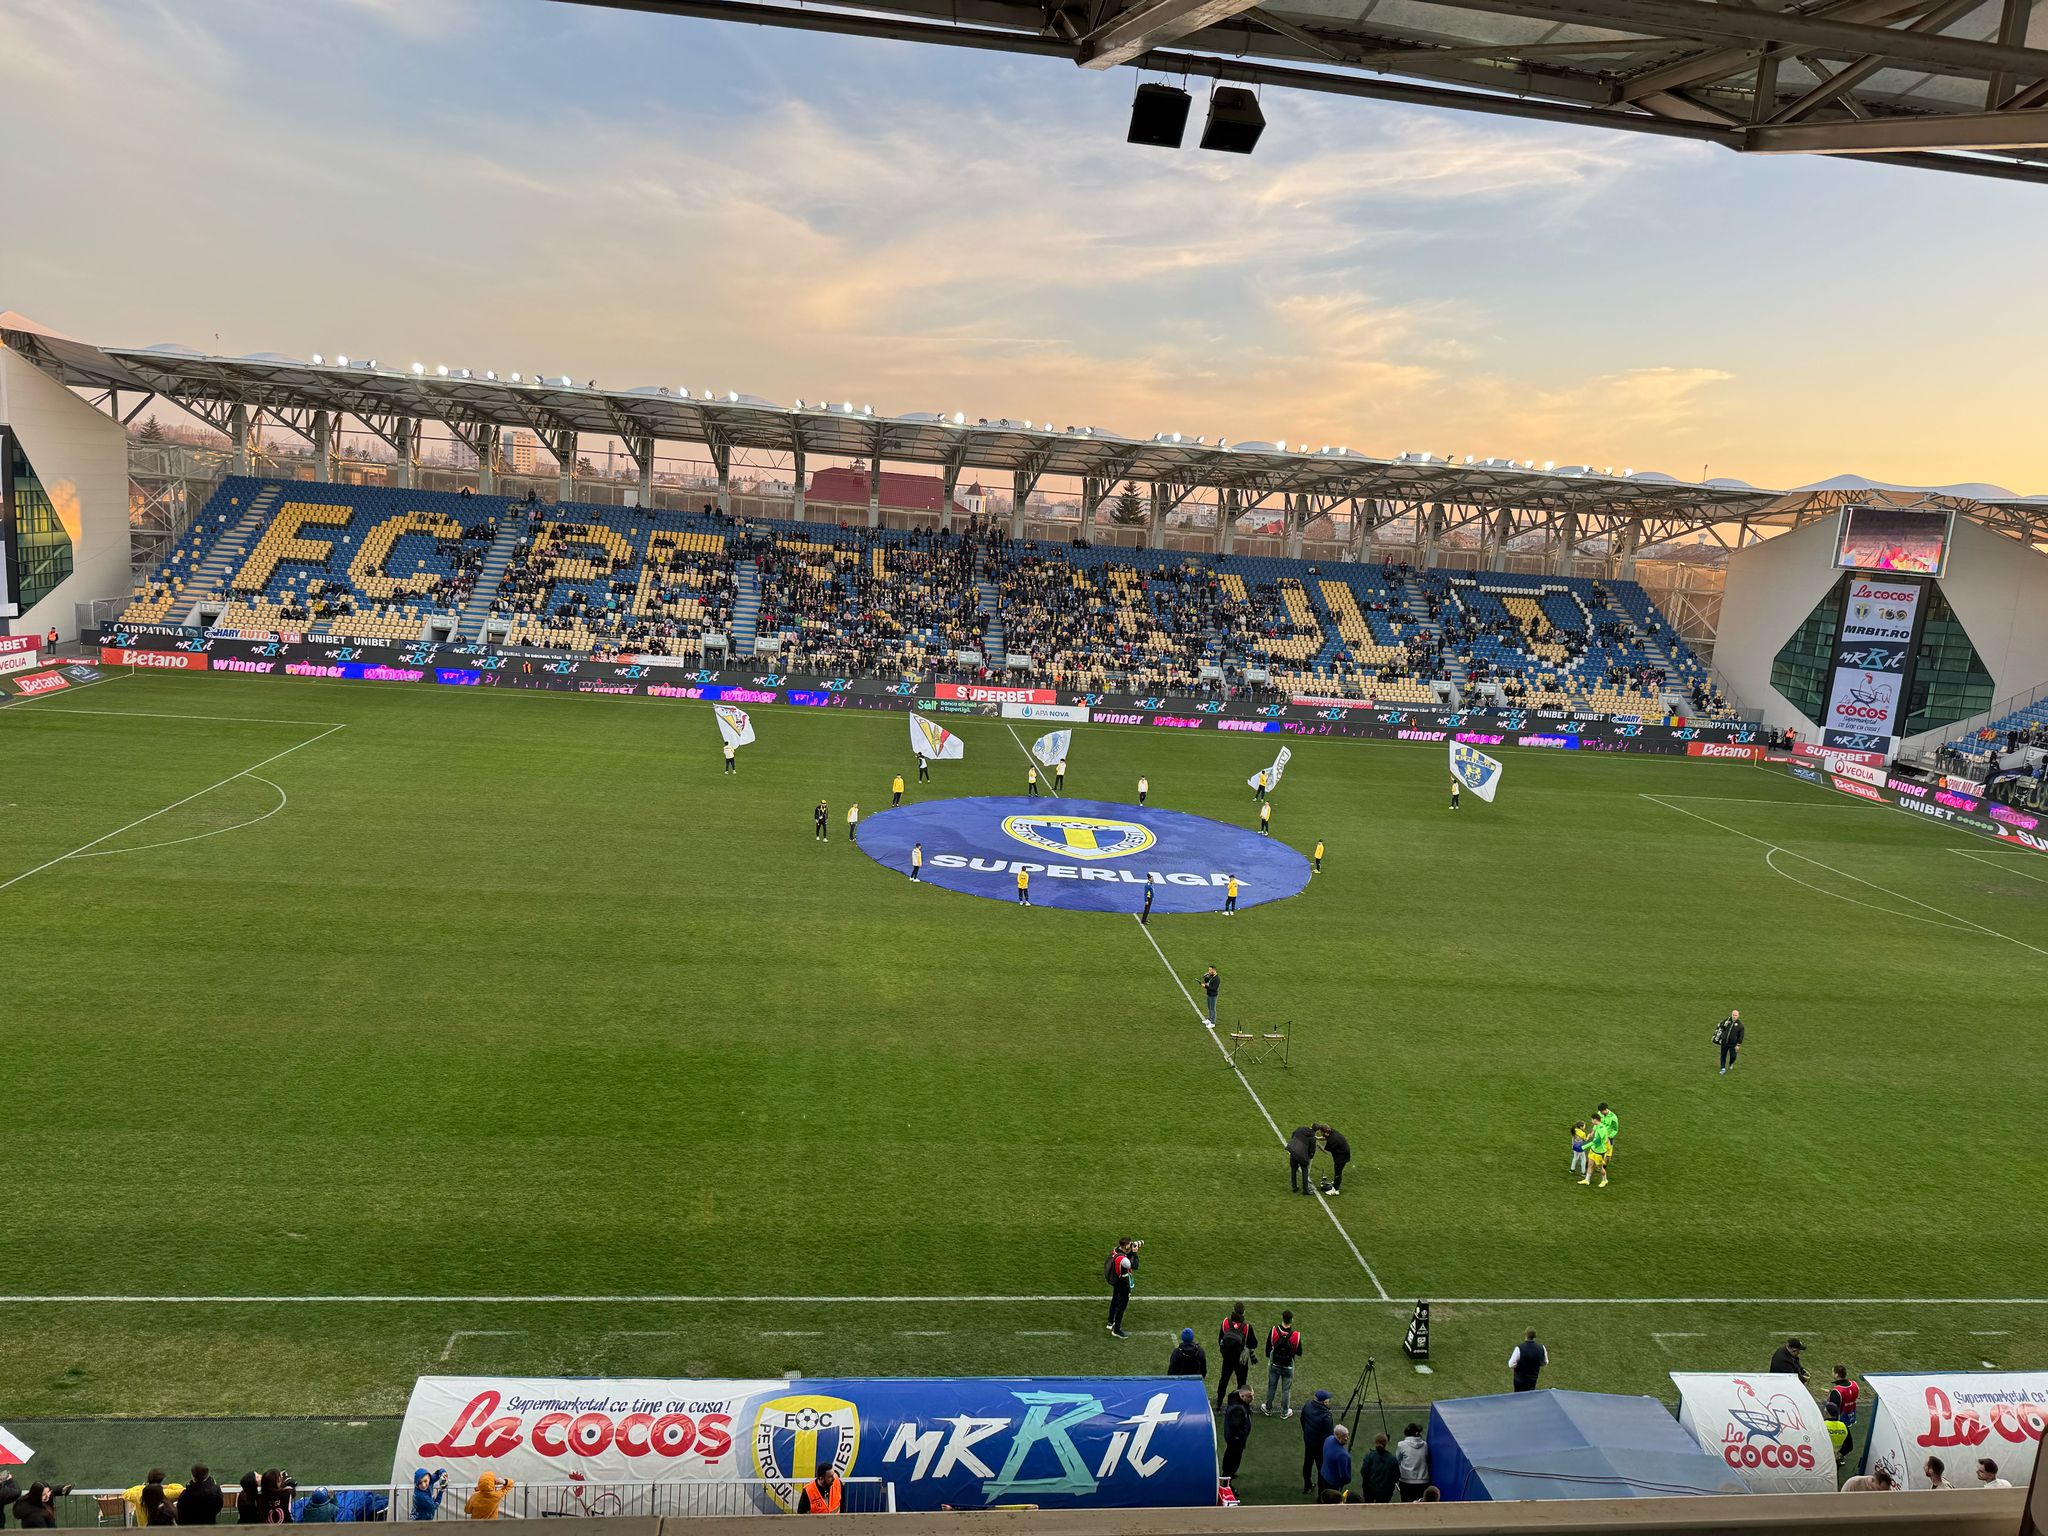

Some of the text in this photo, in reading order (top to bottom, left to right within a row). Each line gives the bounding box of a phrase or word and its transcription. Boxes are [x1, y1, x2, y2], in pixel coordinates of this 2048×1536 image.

[113, 623, 184, 637] CARPATINA
[217, 629, 268, 640] HARY AUTO
[1844, 625, 1910, 639] MRBIT.RO
[308, 635, 392, 648] UNIBET UNIBET
[122, 650, 188, 669] Betano
[213, 657, 275, 673] winner
[20, 675, 65, 692] Betano
[956, 686, 1036, 704] SUPERBET
[1035, 709, 1070, 718] APA NOVA
[1094, 712, 1144, 725] winner
[1537, 710, 1605, 722] UNIBET UNIBET
[1708, 722, 1747, 731] RPATINA
[1398, 729, 1448, 742] winner
[1702, 744, 1751, 758] Betano
[1805, 746, 1872, 763] SUPERBET
[1846, 765, 1875, 781] VEOLIA
[1833, 778, 1878, 799] Betano
[1888, 778, 1928, 798] winner
[1899, 797, 1956, 822] UNIBET
[1953, 1388, 2029, 1410] Supermarketul
[418, 1390, 523, 1459] La
[1917, 1386, 1990, 1447] La
[1721, 1422, 1745, 1443] La
